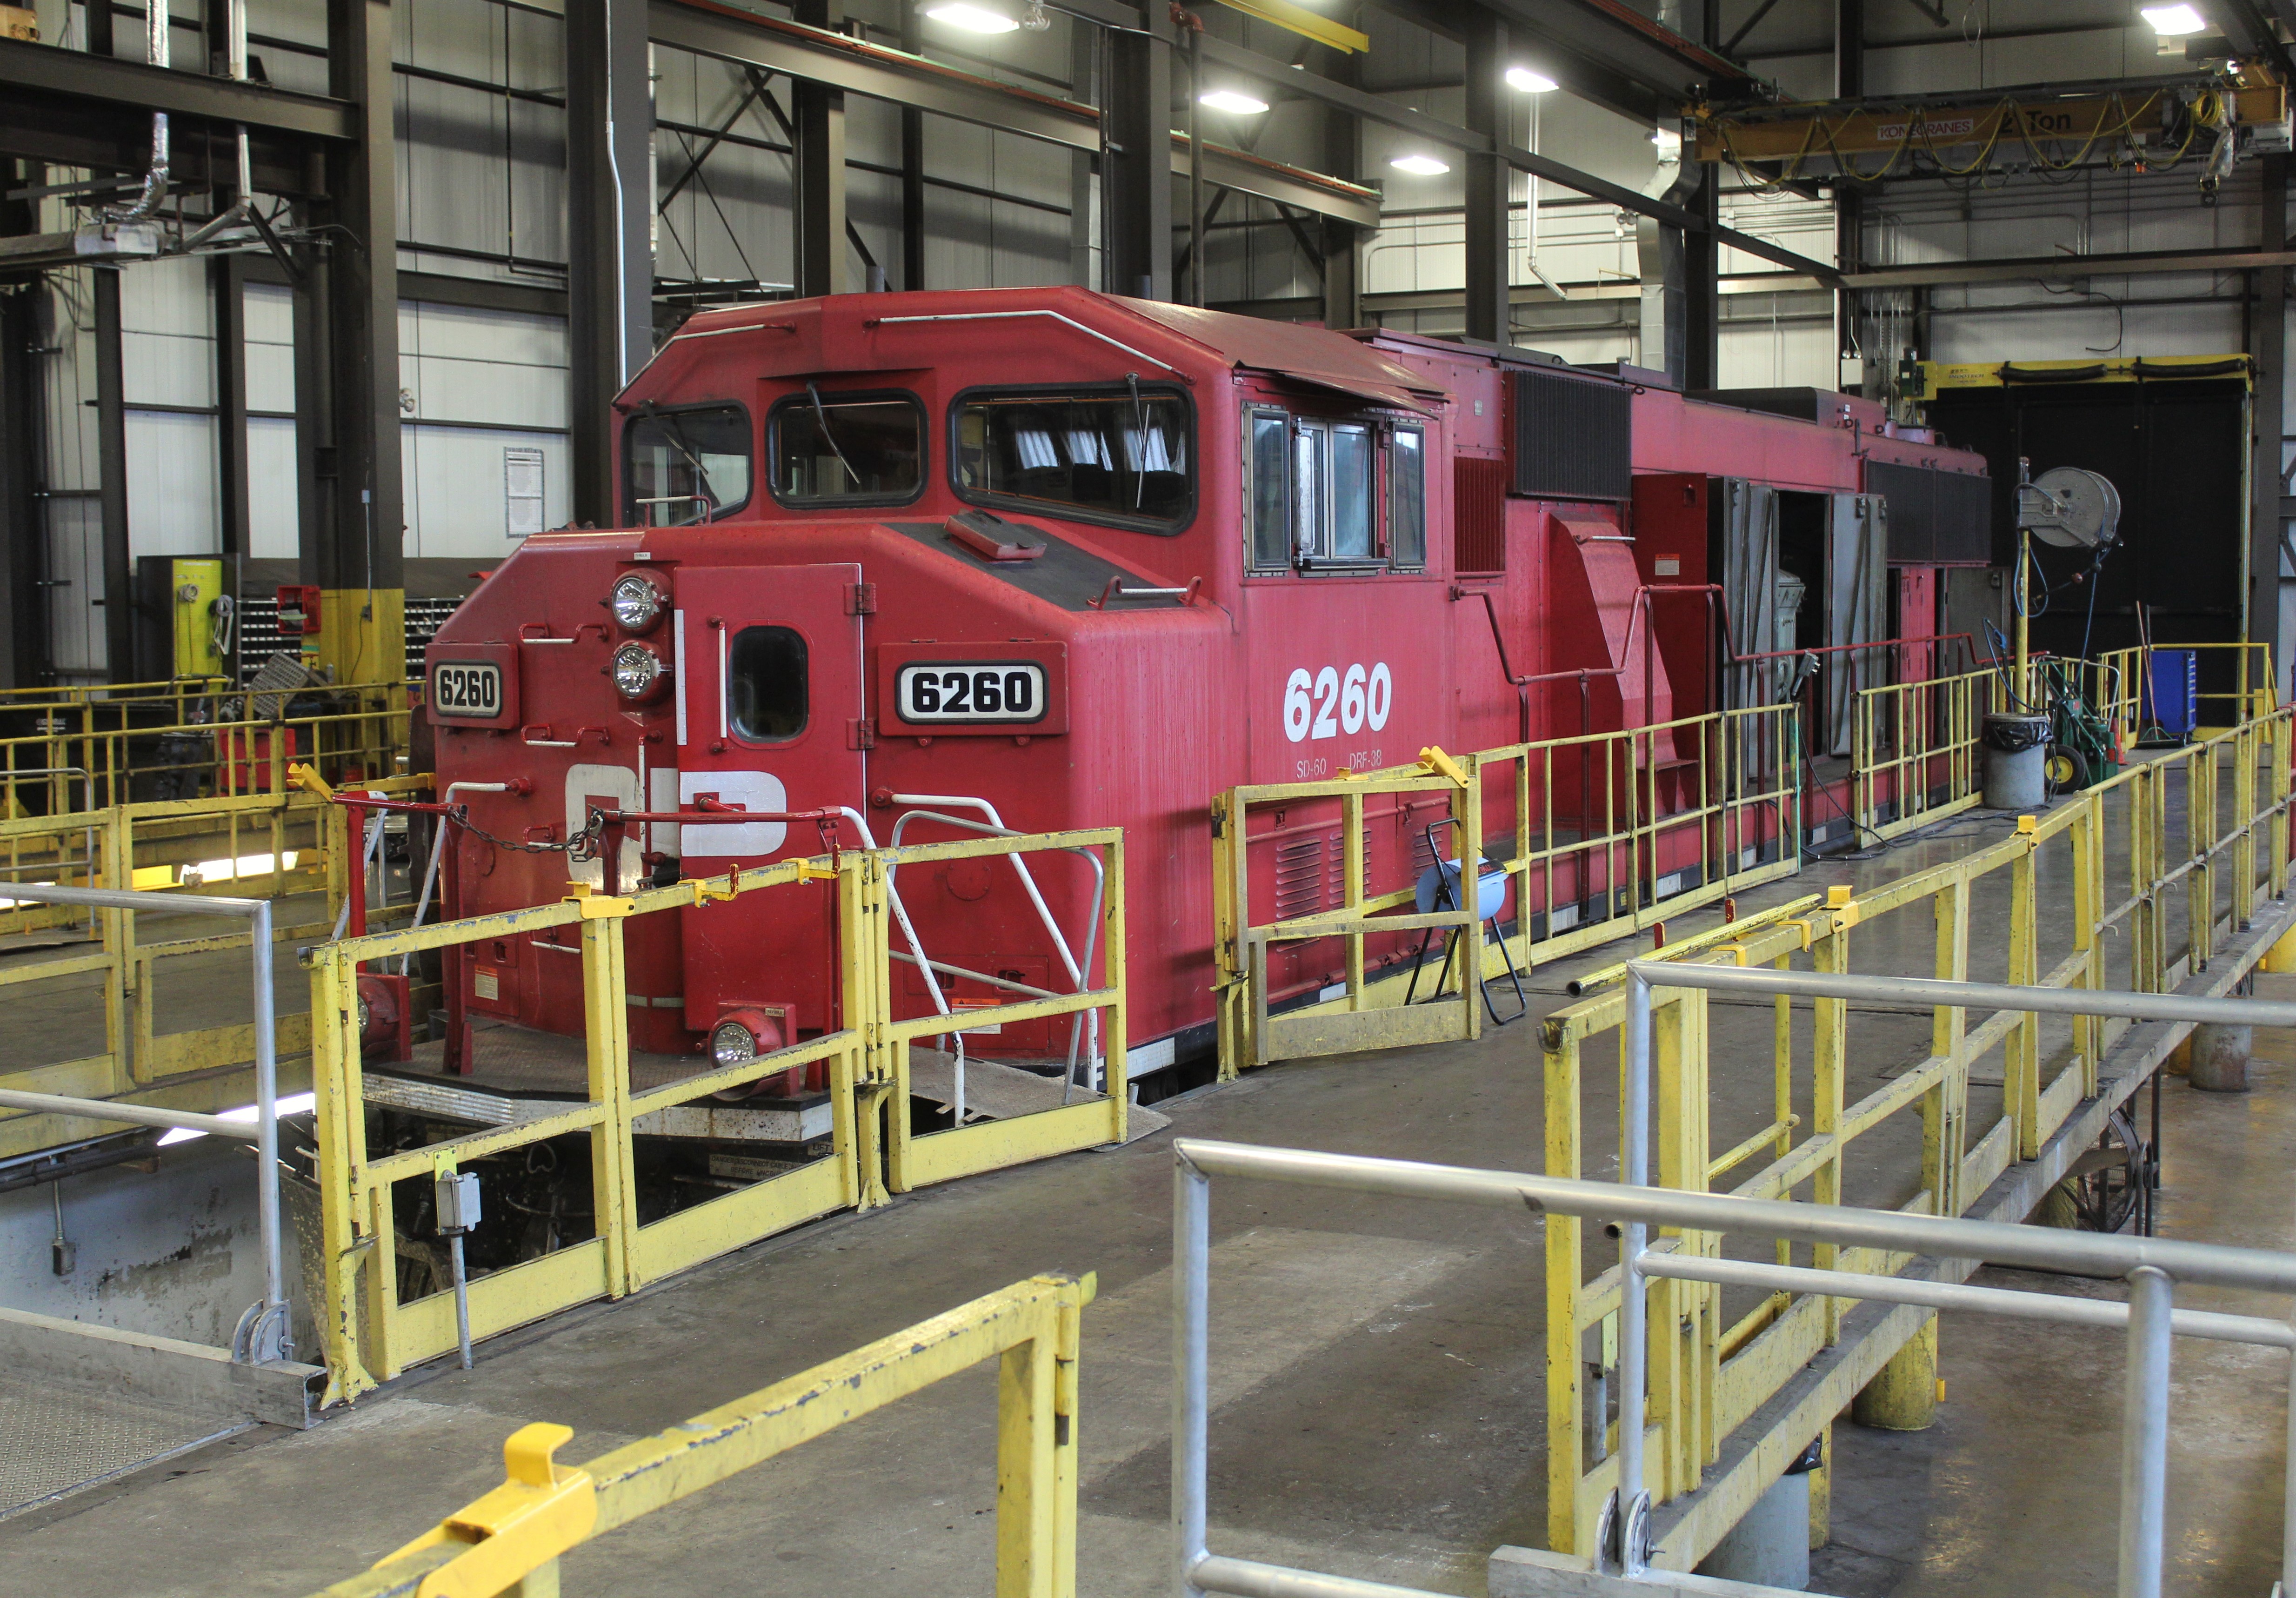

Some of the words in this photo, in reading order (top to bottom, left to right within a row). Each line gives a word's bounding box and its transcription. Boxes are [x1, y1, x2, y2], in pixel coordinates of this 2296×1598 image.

[2025, 110, 2071, 132] Ton
[440, 669, 495, 708] 6260
[912, 672, 1032, 713] 6260
[1284, 662, 1392, 742] 6260
[1296, 758, 1327, 779] SD-60
[1349, 749, 1382, 770] DRF-38
[813, 1143, 830, 1152] LIFT
[730, 1166, 754, 1175] BEFORE
